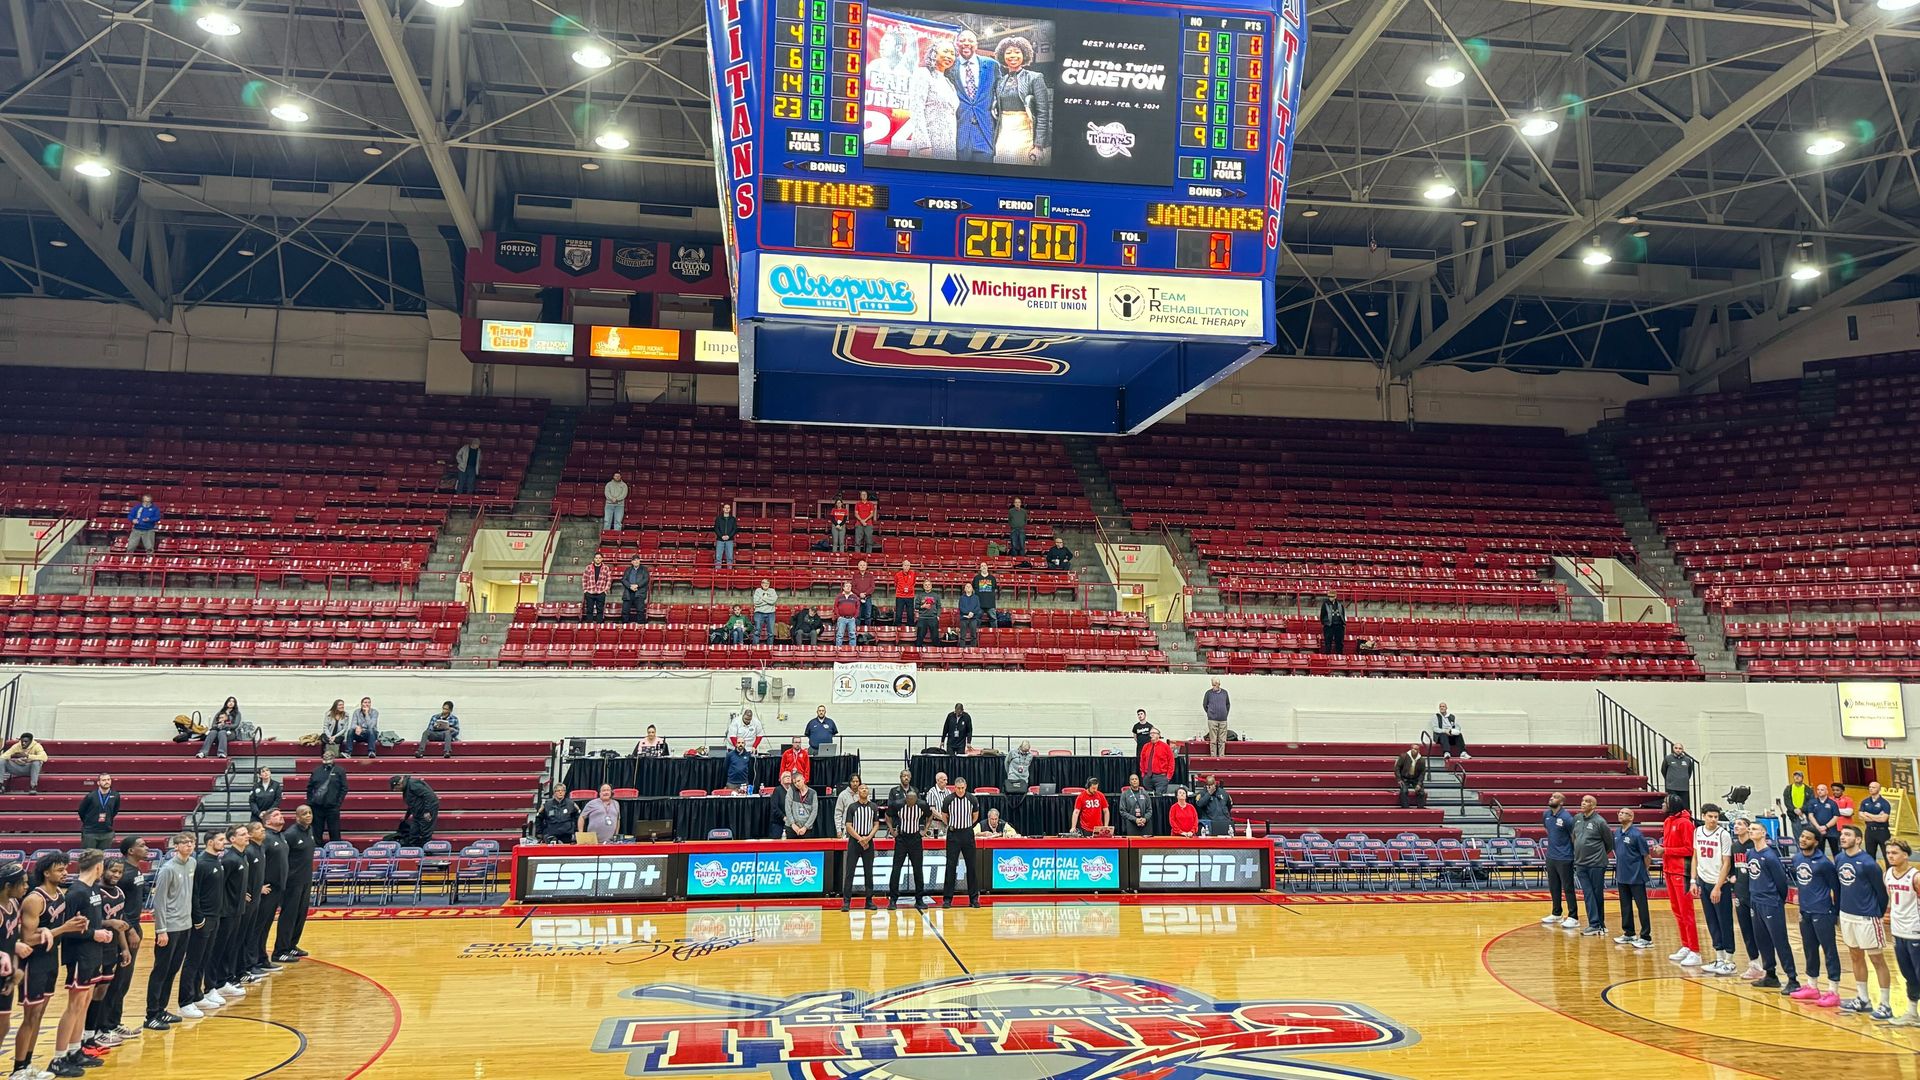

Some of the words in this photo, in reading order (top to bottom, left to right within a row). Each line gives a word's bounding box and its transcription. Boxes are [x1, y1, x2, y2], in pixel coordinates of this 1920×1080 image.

[798, 0, 804, 18] 1
[813, 1, 826, 21] 0
[849, 3, 861, 24] 0
[1191, 17, 1203, 27] NO
[1221, 19, 1228, 28] F
[1245, 21, 1261, 31] PTS
[790, 24, 803, 43] 4
[812, 25, 825, 45] 0
[848, 28, 861, 48] 0
[1198, 32, 1210, 52] 0
[1218, 33, 1230, 53] 0
[1250, 36, 1262, 55] 0
[789, 48, 802, 69] 6
[811, 50, 824, 70] 0
[847, 53, 860, 73] 0
[1063, 58, 1090, 68] Earl
[1204, 56, 1209, 75] 1
[1217, 57, 1229, 77] 0
[1249, 59, 1261, 79] 0
[783, 72, 801, 92] 14
[811, 74, 823, 95] 0
[846, 77, 859, 98] 0
[1062, 68, 1166, 90] CURETON
[1196, 79, 1208, 99] 2
[1216, 80, 1228, 100] 0
[1248, 83, 1260, 103] 0
[774, 97, 801, 117] 23
[810, 99, 823, 119] 0
[845, 102, 858, 122] 0
[1195, 104, 1207, 122] 4
[1215, 104, 1227, 124] 0
[1248, 106, 1259, 126] 0
[791, 132, 819, 142] TEAM
[1089, 133, 1132, 146] TITANS
[1194, 127, 1206, 146] 9
[1213, 128, 1226, 148] 0
[1247, 130, 1258, 149] 0
[1266, 27, 1299, 249] TITANS
[789, 142, 820, 152] FOULS
[845, 135, 857, 155] 0
[810, 162, 846, 173] BONUS
[1193, 159, 1204, 178] 0
[1216, 160, 1242, 170] TEAM
[1214, 170, 1242, 180] FOULS
[777, 178, 874, 207] TITANS
[1189, 187, 1222, 197] BONUS
[928, 199, 958, 210] POSS
[999, 200, 1033, 211] PERIOD
[1043, 198, 1048, 216] 1
[894, 219, 915, 229] TOL
[1148, 203, 1264, 231] JAGUARS
[832, 210, 854, 248] 0
[897, 233, 910, 251] 4
[967, 220, 1075, 260] 20:00
[1120, 232, 1140, 241] TOL
[501, 245, 536, 253] HORIZON
[1124, 247, 1135, 264] 4
[1209, 233, 1231, 269] 0
[672, 261, 710, 272] CLEVELAND
[769, 264, 914, 315] Absopure
[972, 279, 1046, 299] Michigan
[1051, 283, 1087, 300] First
[1148, 287, 1186, 301] TEAM
[817, 300, 843, 308] SINCE
[1027, 300, 1058, 309] CREDIT
[1061, 301, 1087, 311] UNION
[1149, 301, 1249, 317] REHABILITATION
[1150, 315, 1199, 326] PHYSICAL
[1202, 317, 1246, 328] THERAPY
[490, 326, 532, 337] TITAN
[493, 337, 528, 348] CLUB
[1085, 799, 1100, 808] 313
[1700, 847, 1714, 858] 20
[731, 861, 781, 873] OFFICIAL
[1000, 865, 1028, 873] TITANS
[1032, 857, 1079, 868] OFFICIAL
[1083, 863, 1111, 873] TITANS
[1140, 855, 1258, 882] ESPN+
[533, 862, 661, 890] ESPN+
[695, 869, 727, 878] TITANS
[785, 867, 816, 876] TITANS
[1031, 869, 1080, 880] PARTNER
[730, 873, 782, 886] PARTNER
[1895, 892, 1899, 905] 1
[795, 1008, 1011, 1023] DETROIT
[1029, 1003, 1202, 1018] MERCY
[622, 1003, 1393, 1068] TITANS
